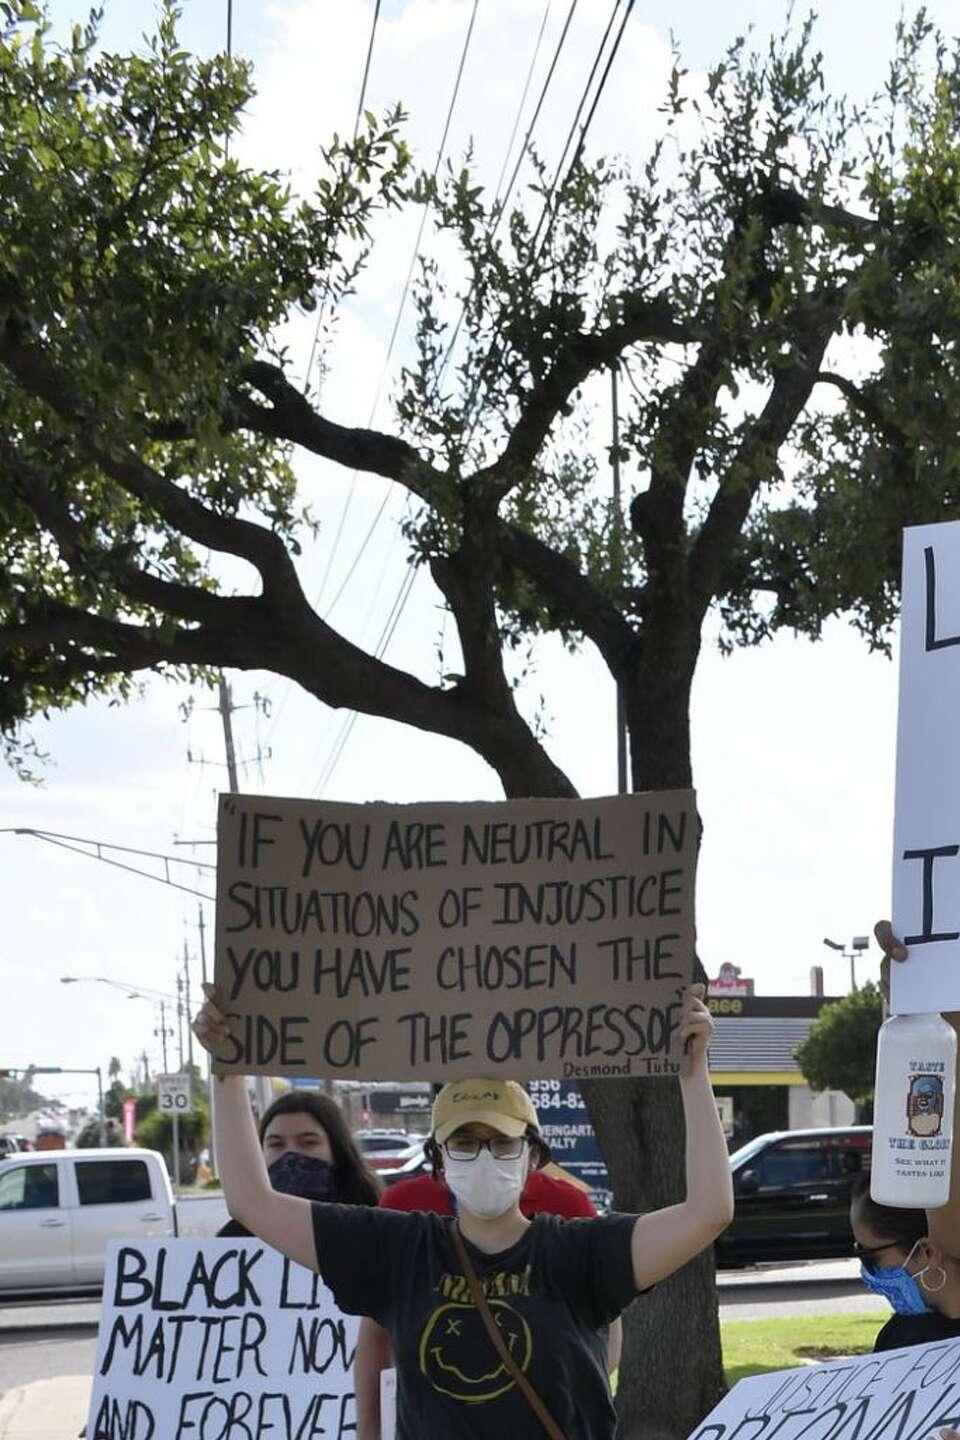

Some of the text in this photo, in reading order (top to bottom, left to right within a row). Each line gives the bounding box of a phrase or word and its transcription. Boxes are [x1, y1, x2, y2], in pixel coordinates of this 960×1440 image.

[299, 818, 370, 878] YOU
[382, 820, 448, 870] ARE
[462, 817, 615, 866] NEUTRAL
[642, 811, 687, 855] IN
[226, 868, 684, 937] SITUATIONS OF INJUSTICE
[226, 933, 684, 1001] YOU HAVE CHOSEN THE
[215, 1012, 310, 1065] SIDE
[323, 1016, 380, 1068] OF
[397, 1010, 472, 1067] THE
[563, 1056, 681, 1077] Desmond Tutu
[162, 1093, 188, 1109] 30
[114, 1247, 264, 1310] BLACK
[100, 1312, 268, 1384] MATTER
[745, 1354, 908, 1416] JUSTICE
